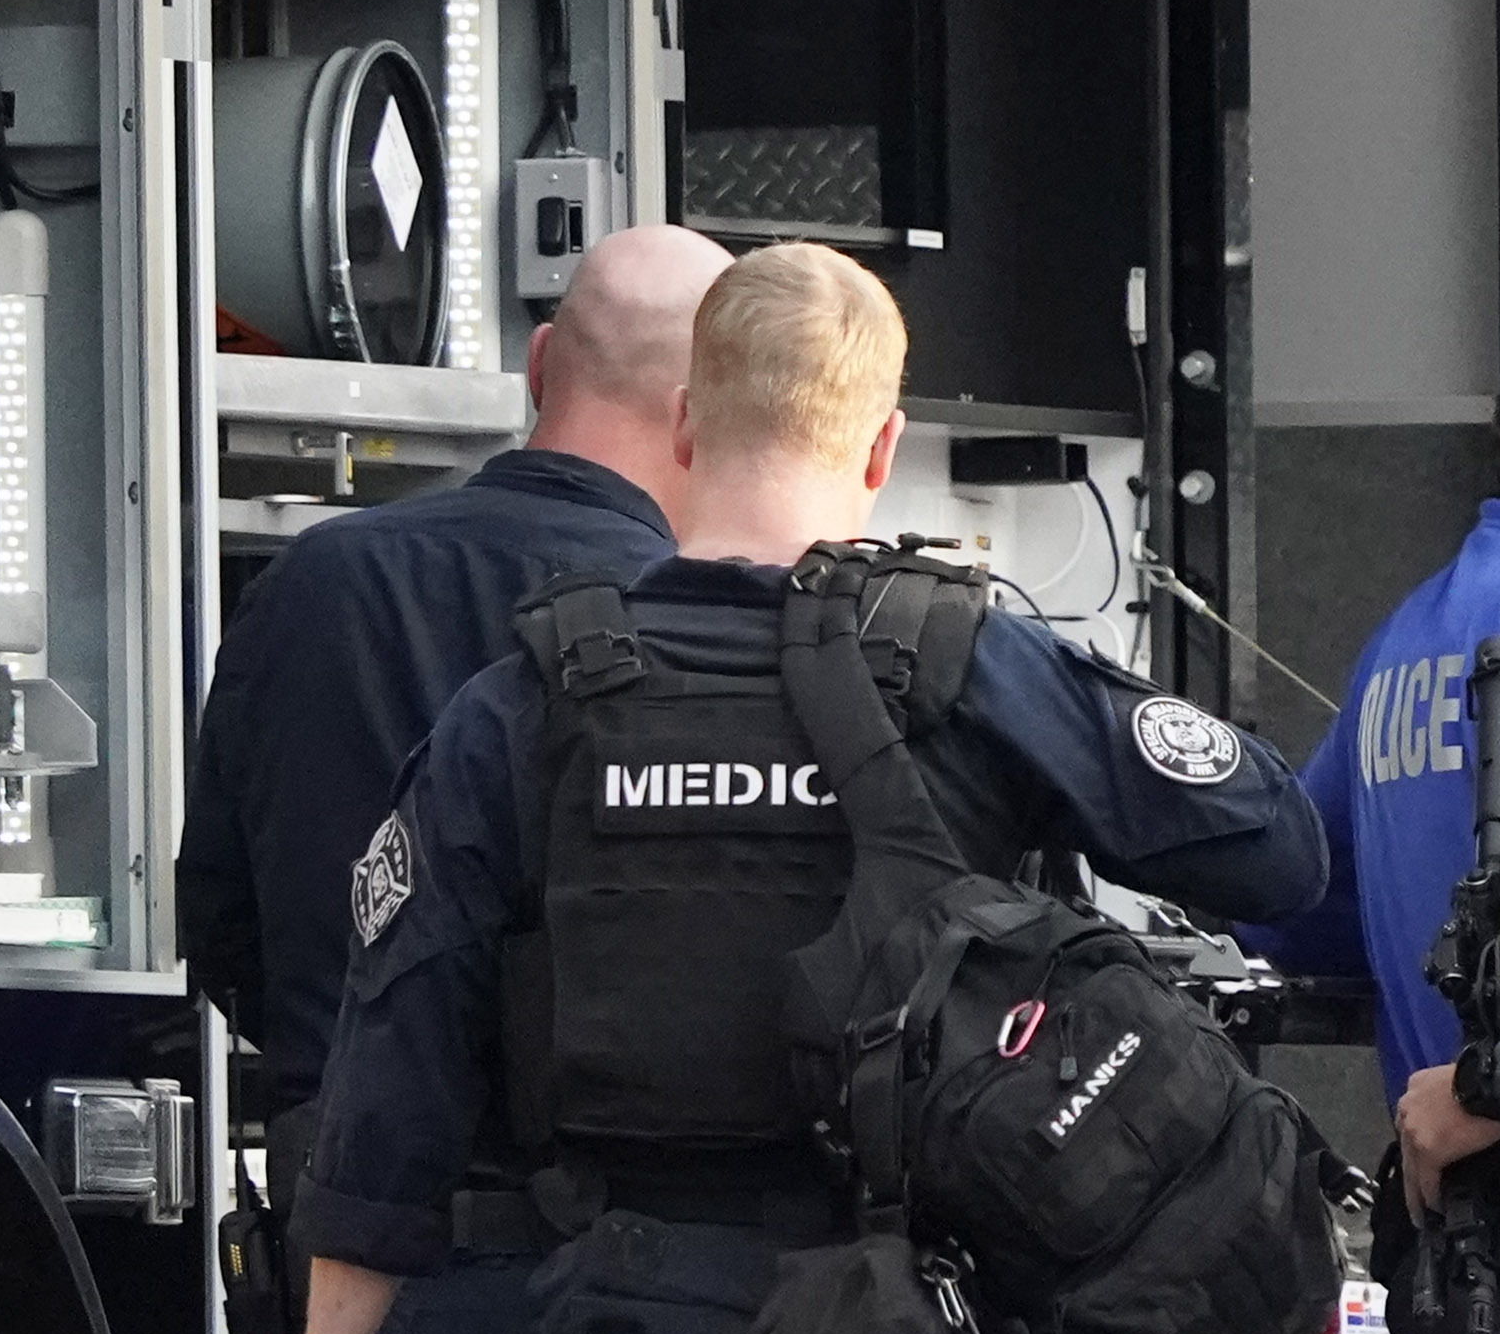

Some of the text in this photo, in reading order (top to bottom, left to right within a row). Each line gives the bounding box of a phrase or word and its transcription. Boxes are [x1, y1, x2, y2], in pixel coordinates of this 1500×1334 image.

[1359, 653, 1466, 790] OLICE
[605, 763, 839, 806] MEDIC
[1050, 1032, 1141, 1137] HANKS
